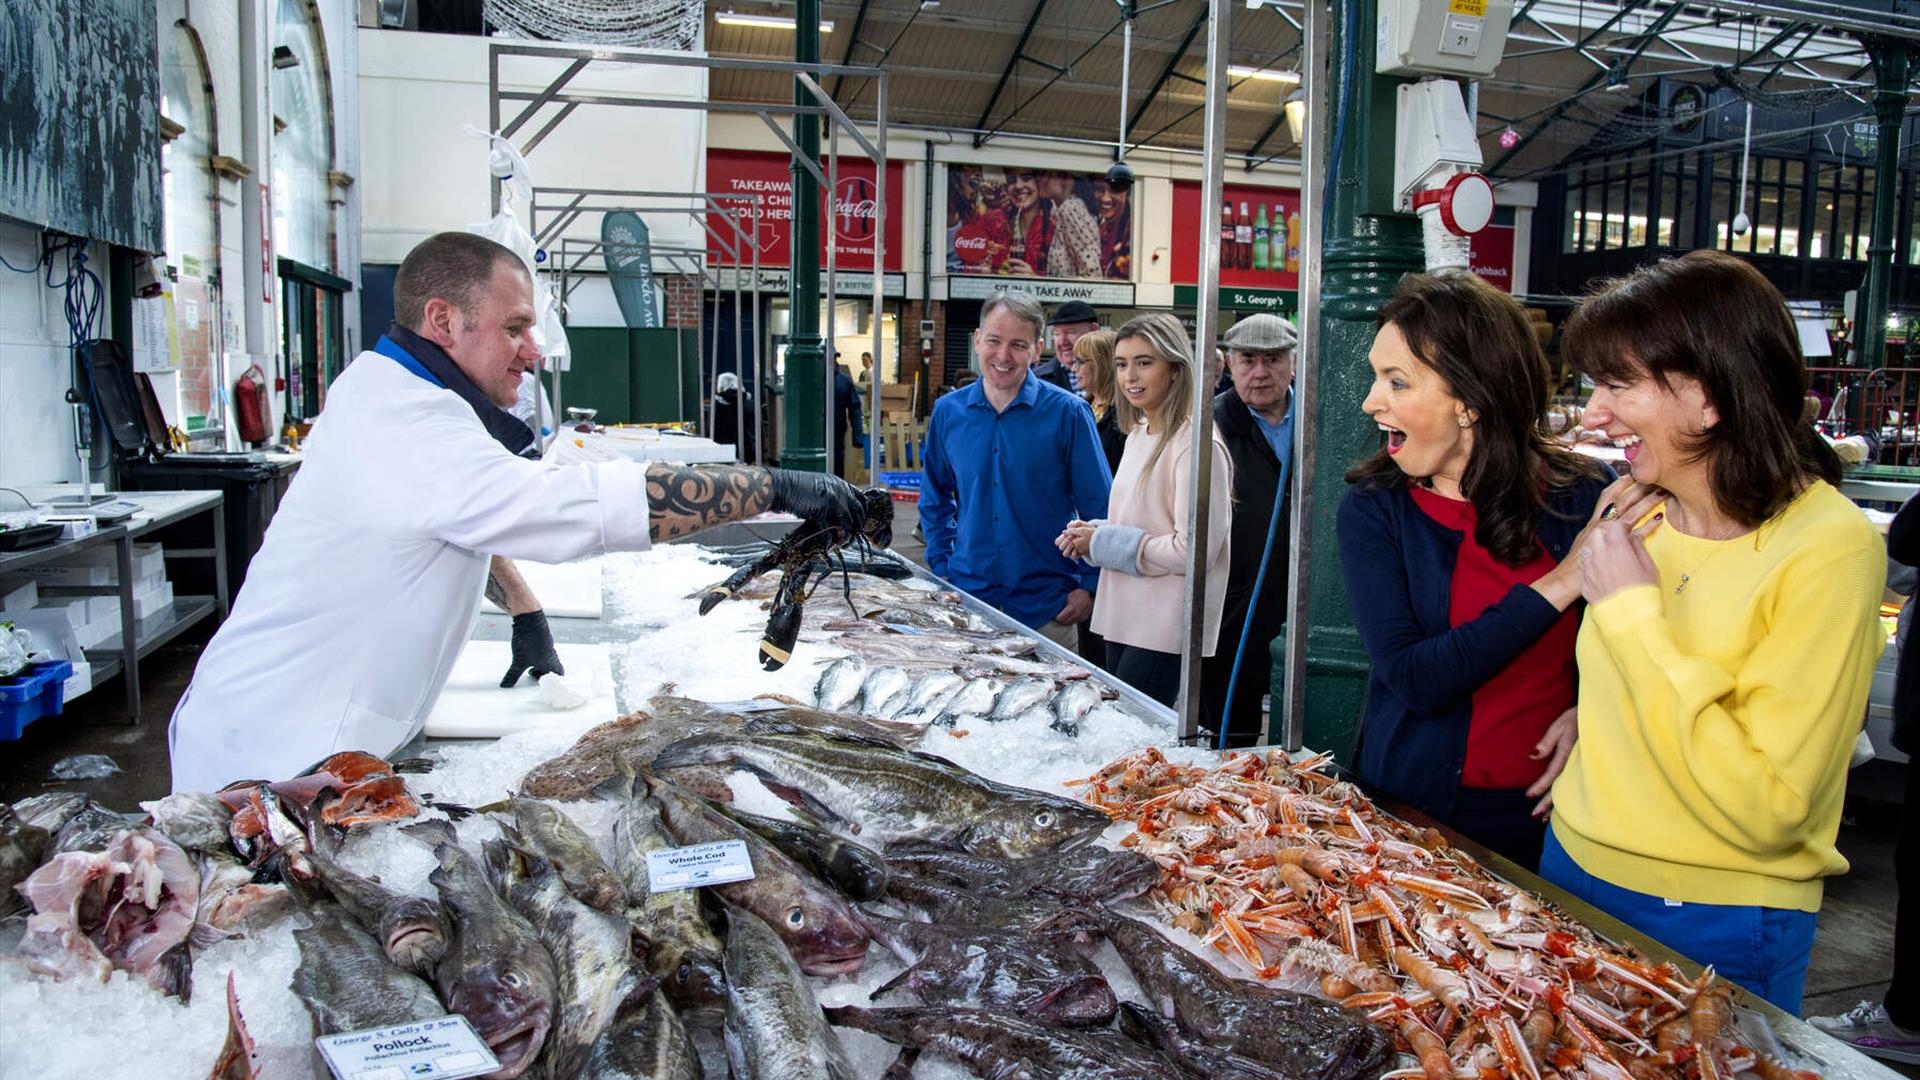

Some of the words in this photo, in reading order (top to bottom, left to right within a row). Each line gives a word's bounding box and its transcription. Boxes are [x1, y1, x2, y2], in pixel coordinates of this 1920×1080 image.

[731, 179, 792, 192] TAKEAWA
[767, 209, 792, 220] HER
[1035, 286, 1059, 297] TAKE
[1063, 287, 1093, 298] AWAY
[1234, 294, 1246, 304] St.
[1248, 294, 1283, 306] George's
[669, 855, 703, 865] Whole
[705, 851, 726, 860] Cod
[333, 1033, 372, 1047] George
[438, 1020, 458, 1029] Son
[373, 1035, 432, 1052] Pollock
